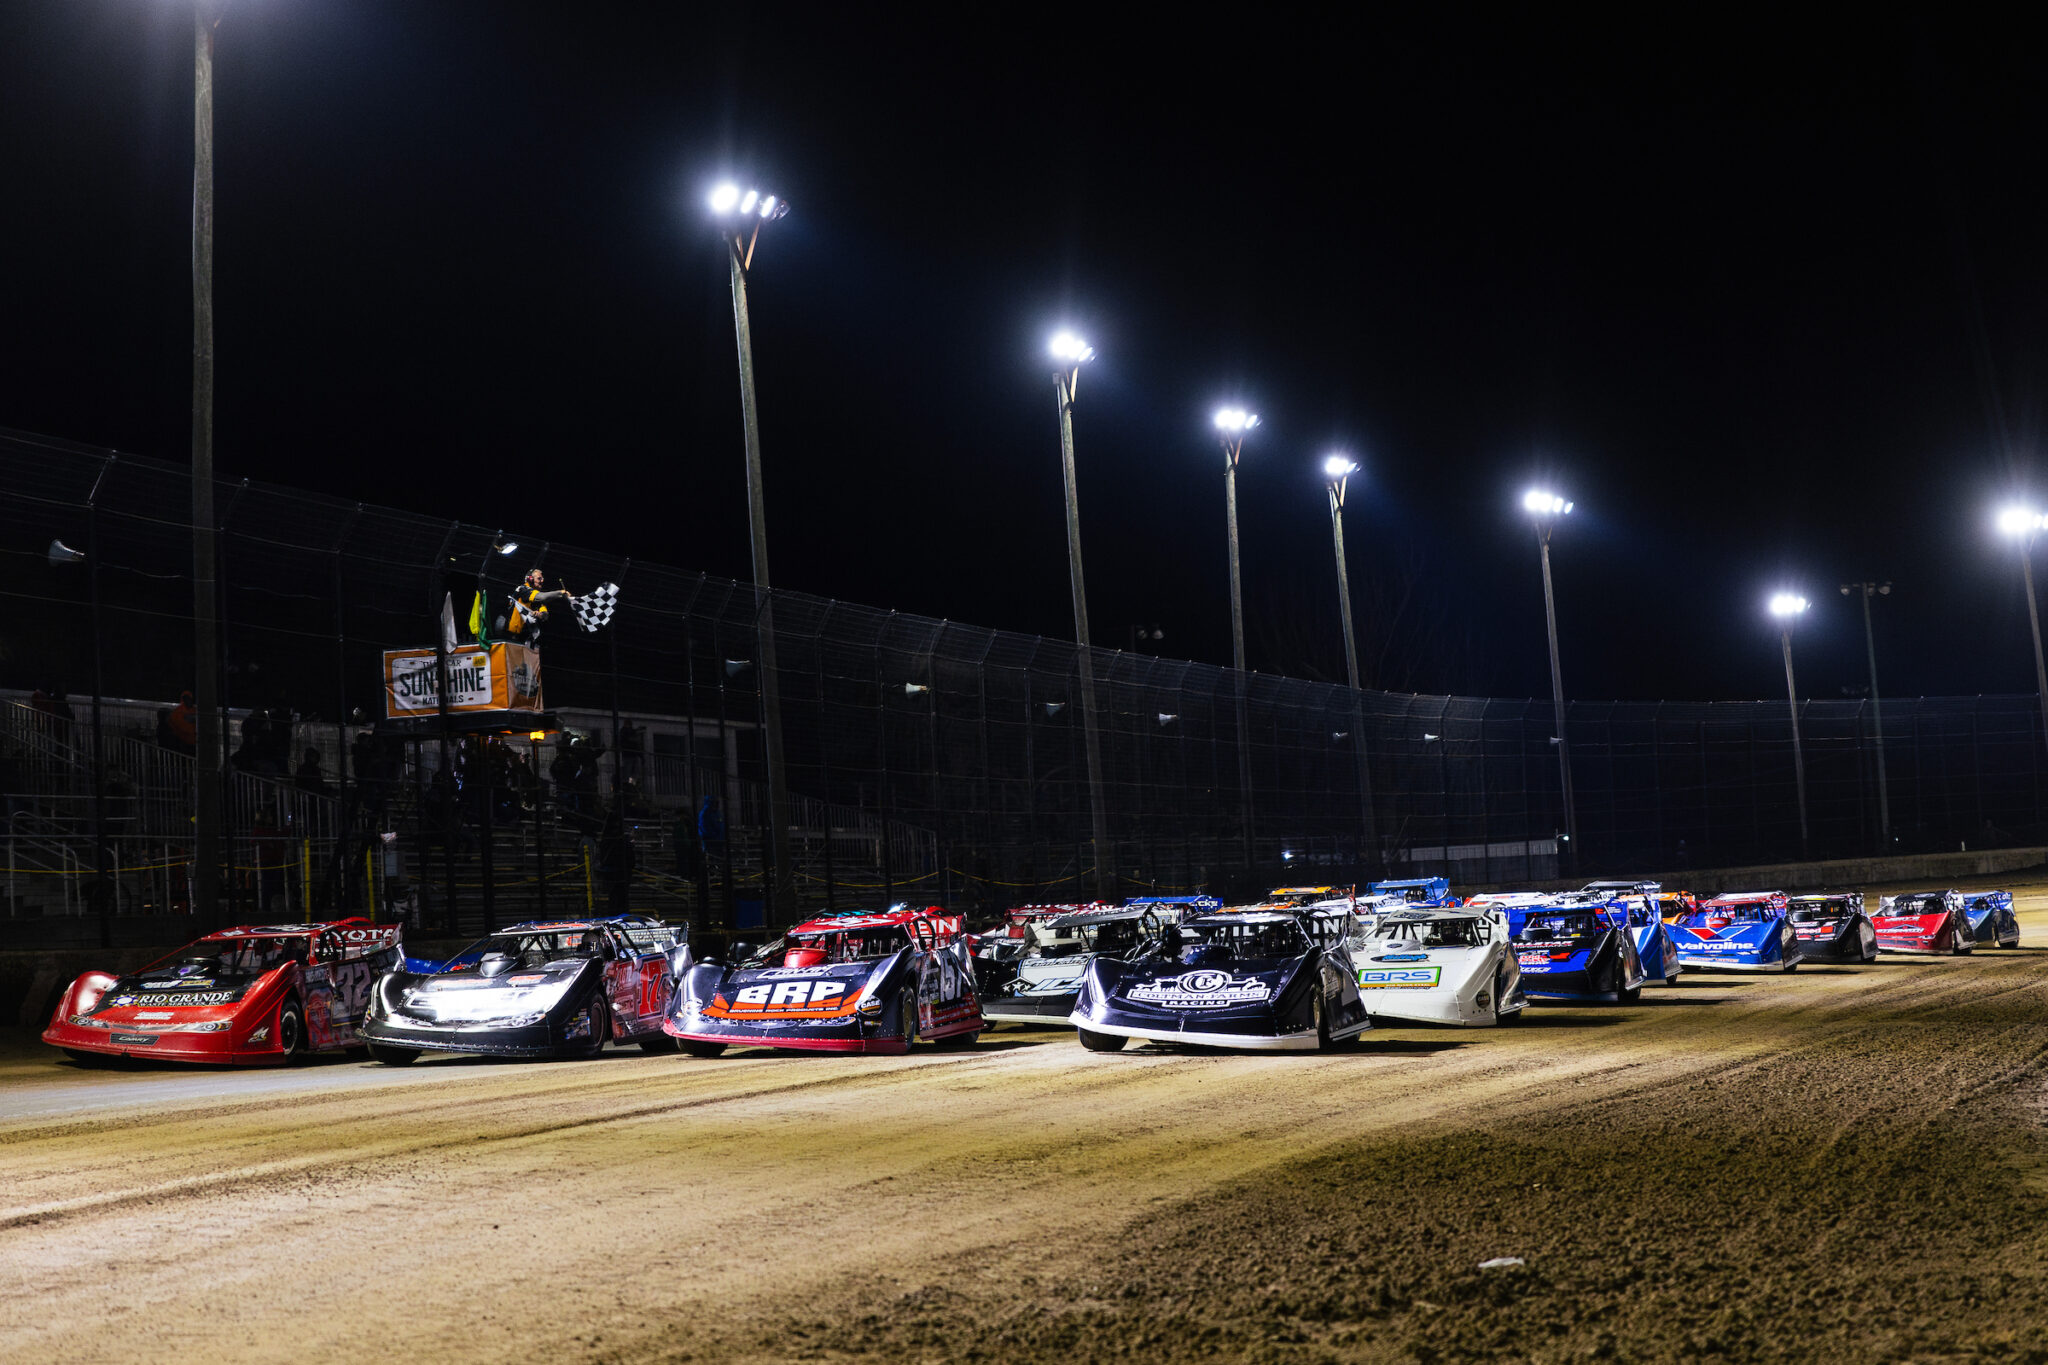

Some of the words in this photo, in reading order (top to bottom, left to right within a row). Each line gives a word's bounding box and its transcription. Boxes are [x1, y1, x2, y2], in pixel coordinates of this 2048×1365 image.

[422, 695, 464, 705] NATIALS
[1676, 942, 1755, 950] Valvoline
[1364, 970, 1432, 982] BRS
[140, 993, 168, 1003] RIO
[169, 991, 233, 1003] GRANDE
[733, 981, 846, 1008] BRP
[861, 1000, 880, 1009] CASE
